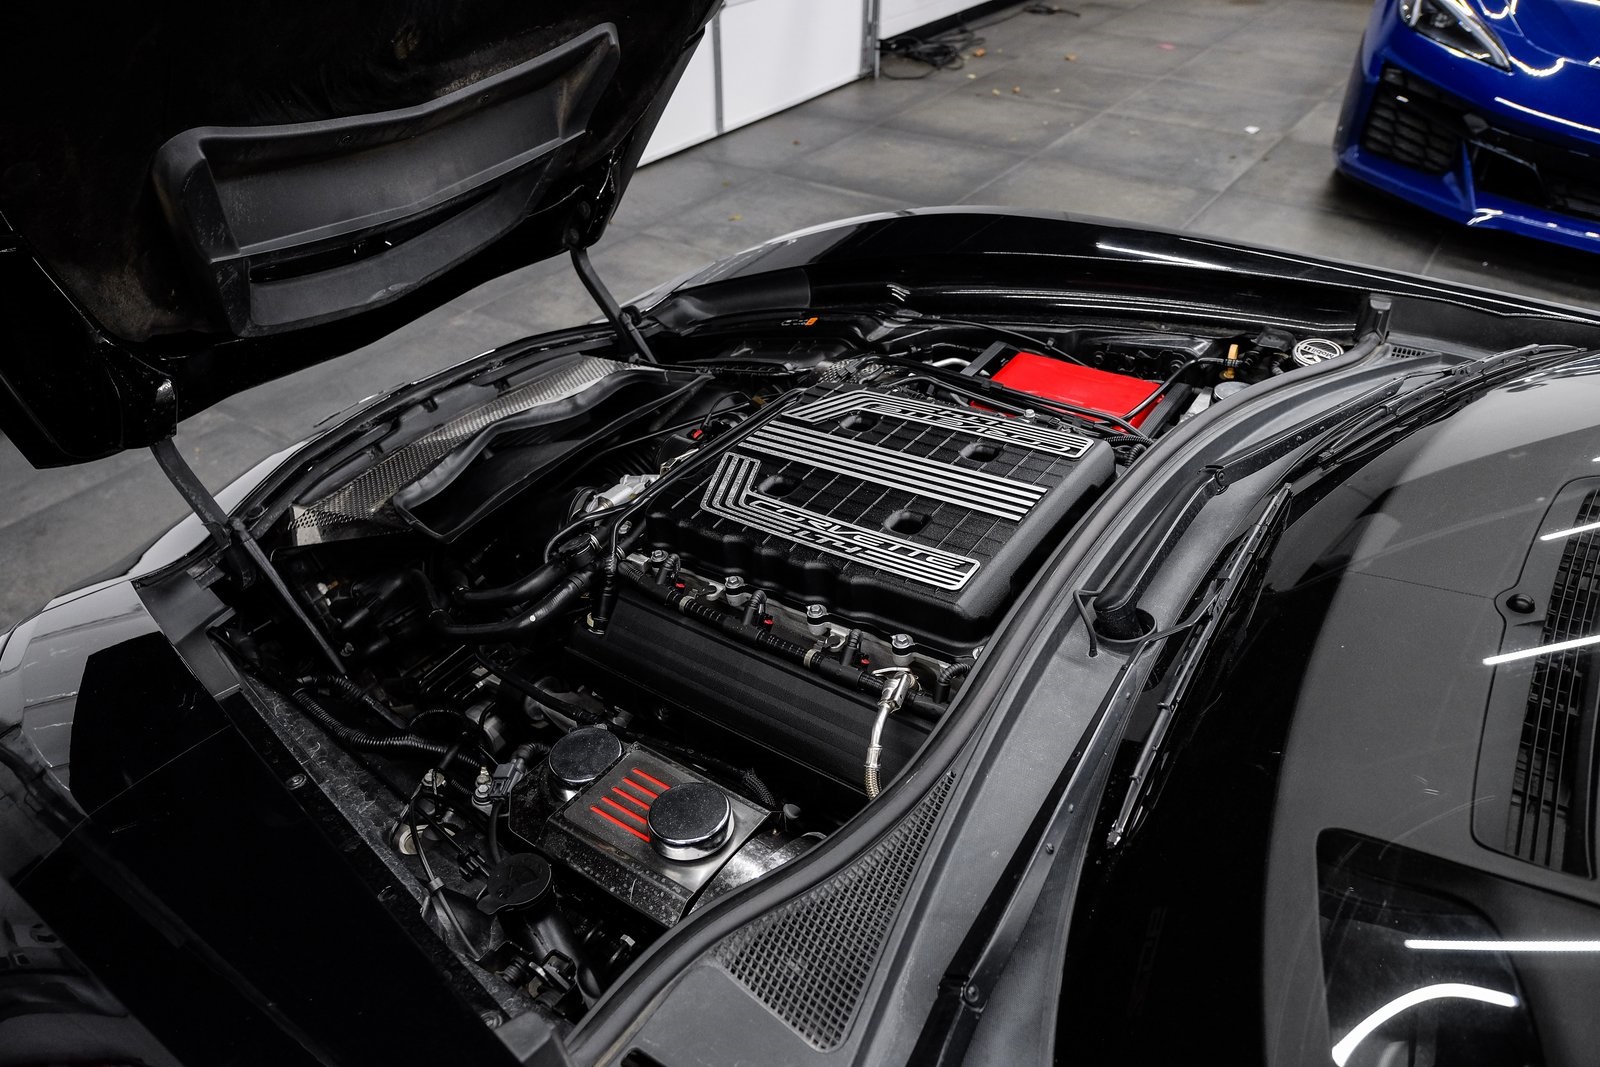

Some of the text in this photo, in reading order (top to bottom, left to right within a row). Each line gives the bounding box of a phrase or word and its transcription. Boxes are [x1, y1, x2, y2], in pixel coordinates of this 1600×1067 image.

[870, 405, 1071, 452] CORVETTE
[937, 410, 999, 426] LT4
[749, 500, 966, 569] CORVETTE
[793, 530, 862, 553] LT4
